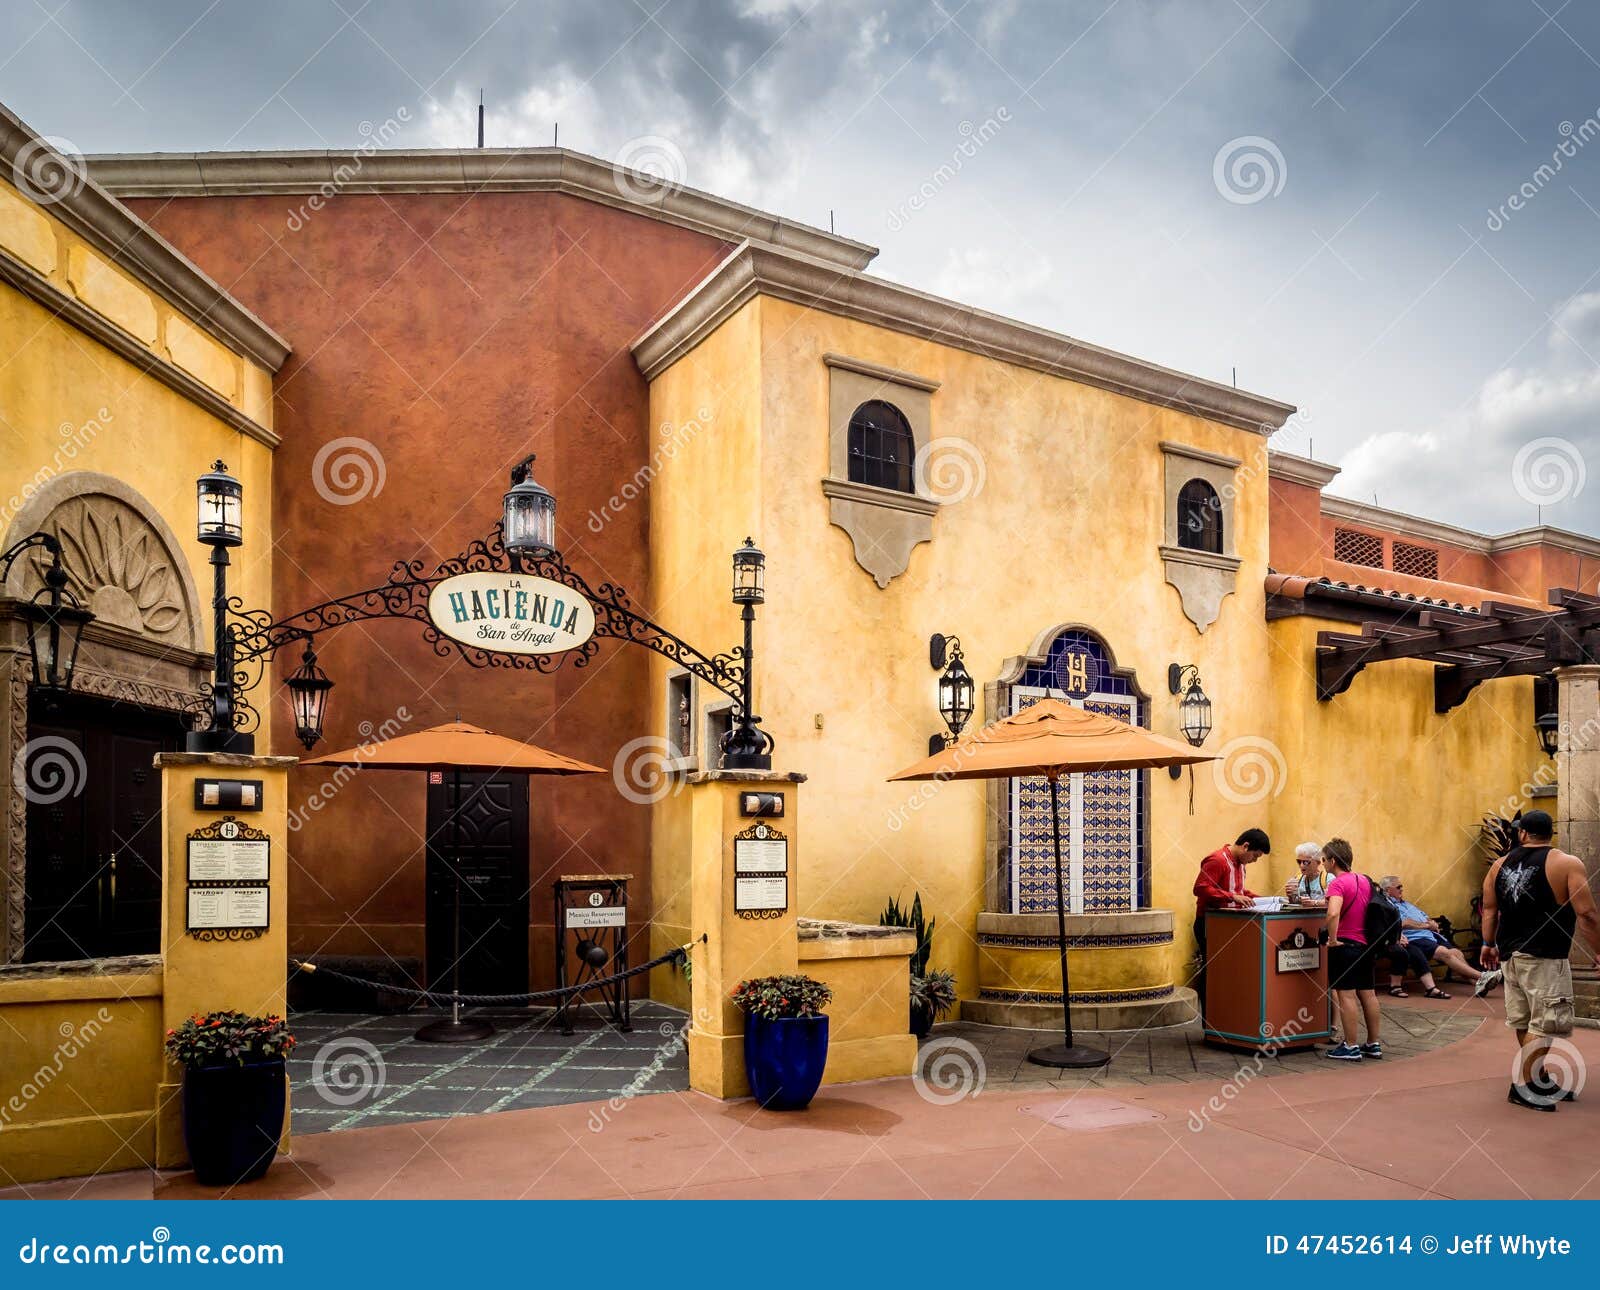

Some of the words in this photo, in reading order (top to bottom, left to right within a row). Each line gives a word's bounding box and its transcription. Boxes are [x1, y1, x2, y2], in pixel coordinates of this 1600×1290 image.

[510, 580, 521, 589] LA
[448, 589, 579, 635] HACIENDA
[510, 621, 520, 629] de
[477, 624, 506, 640] San
[510, 628, 556, 646] Angel
